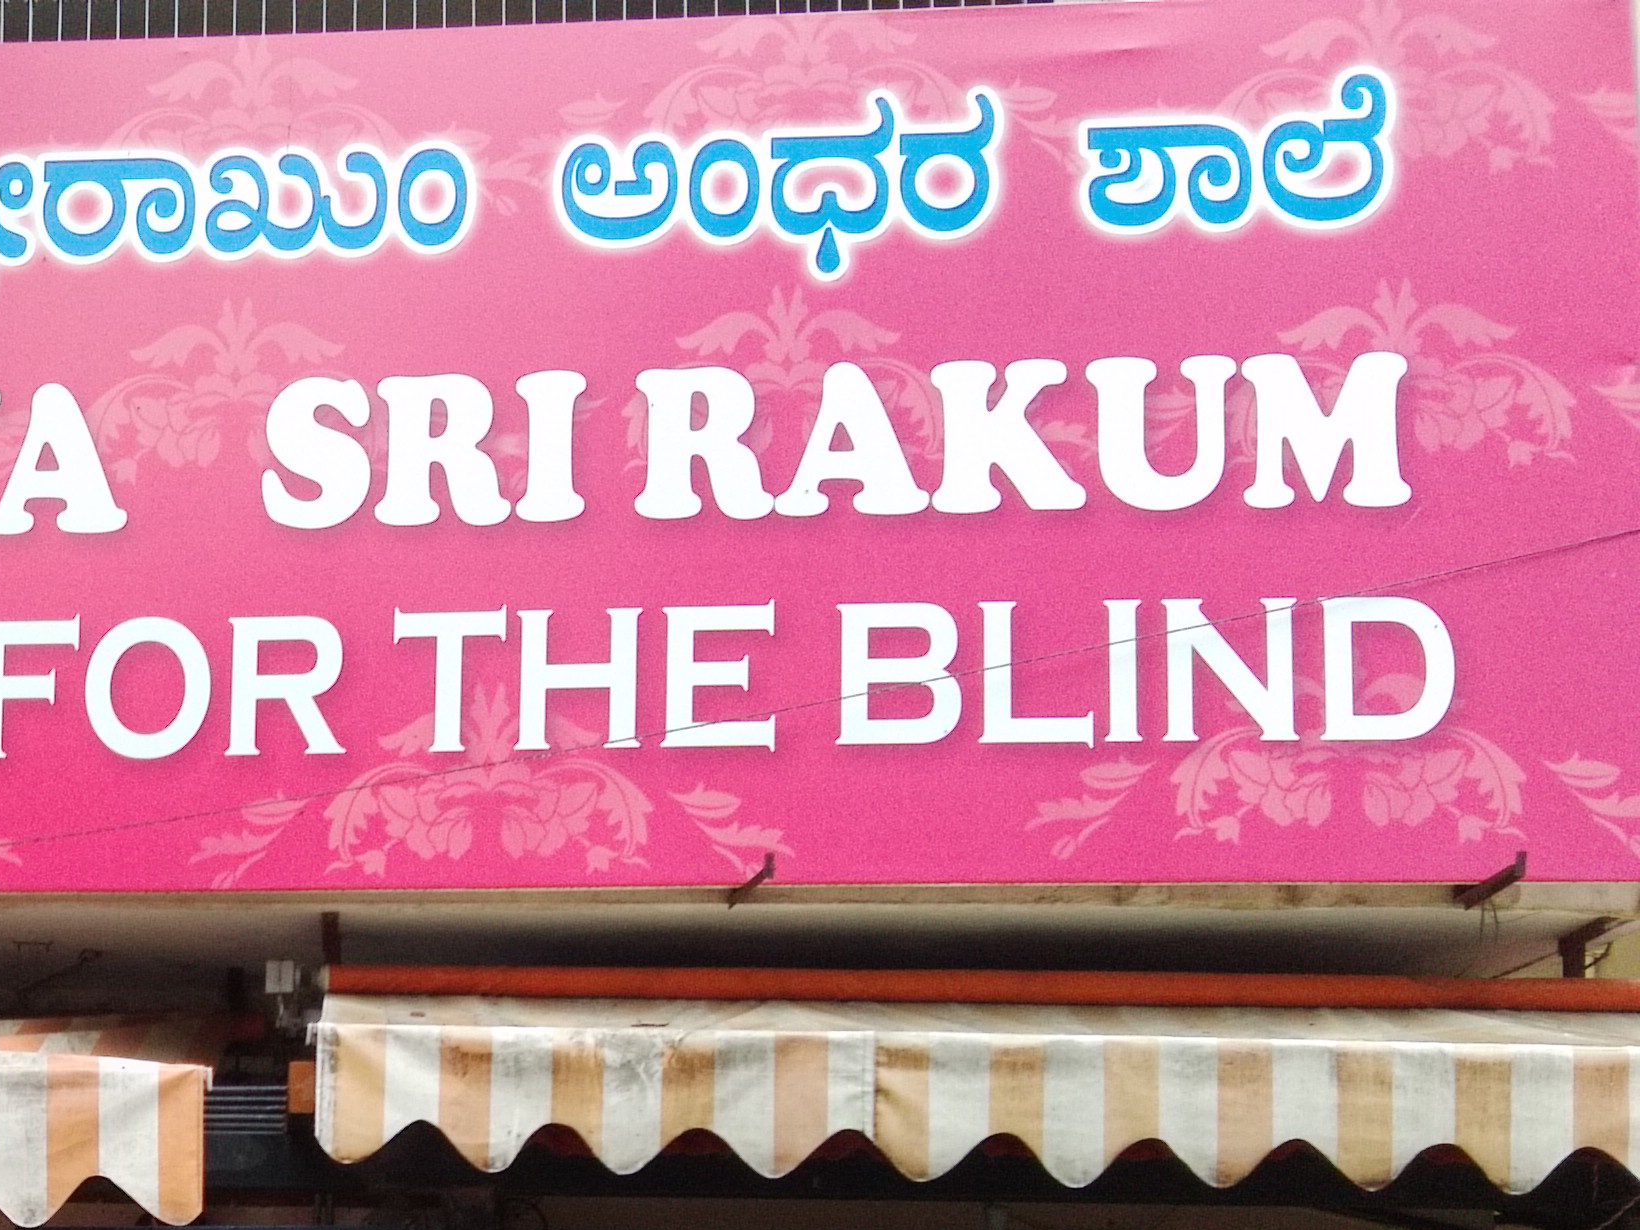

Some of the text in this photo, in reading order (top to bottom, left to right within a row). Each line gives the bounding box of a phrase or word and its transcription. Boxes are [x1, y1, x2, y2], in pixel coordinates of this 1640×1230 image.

[559, 91, 997, 275] ಅಂಧರ
[1085, 71, 1387, 225] ಶಾಲೆ
[261, 370, 587, 530] SRI
[634, 351, 1413, 520] RAKUM
[394, 599, 776, 754] THE
[835, 595, 1456, 750] BLIND
